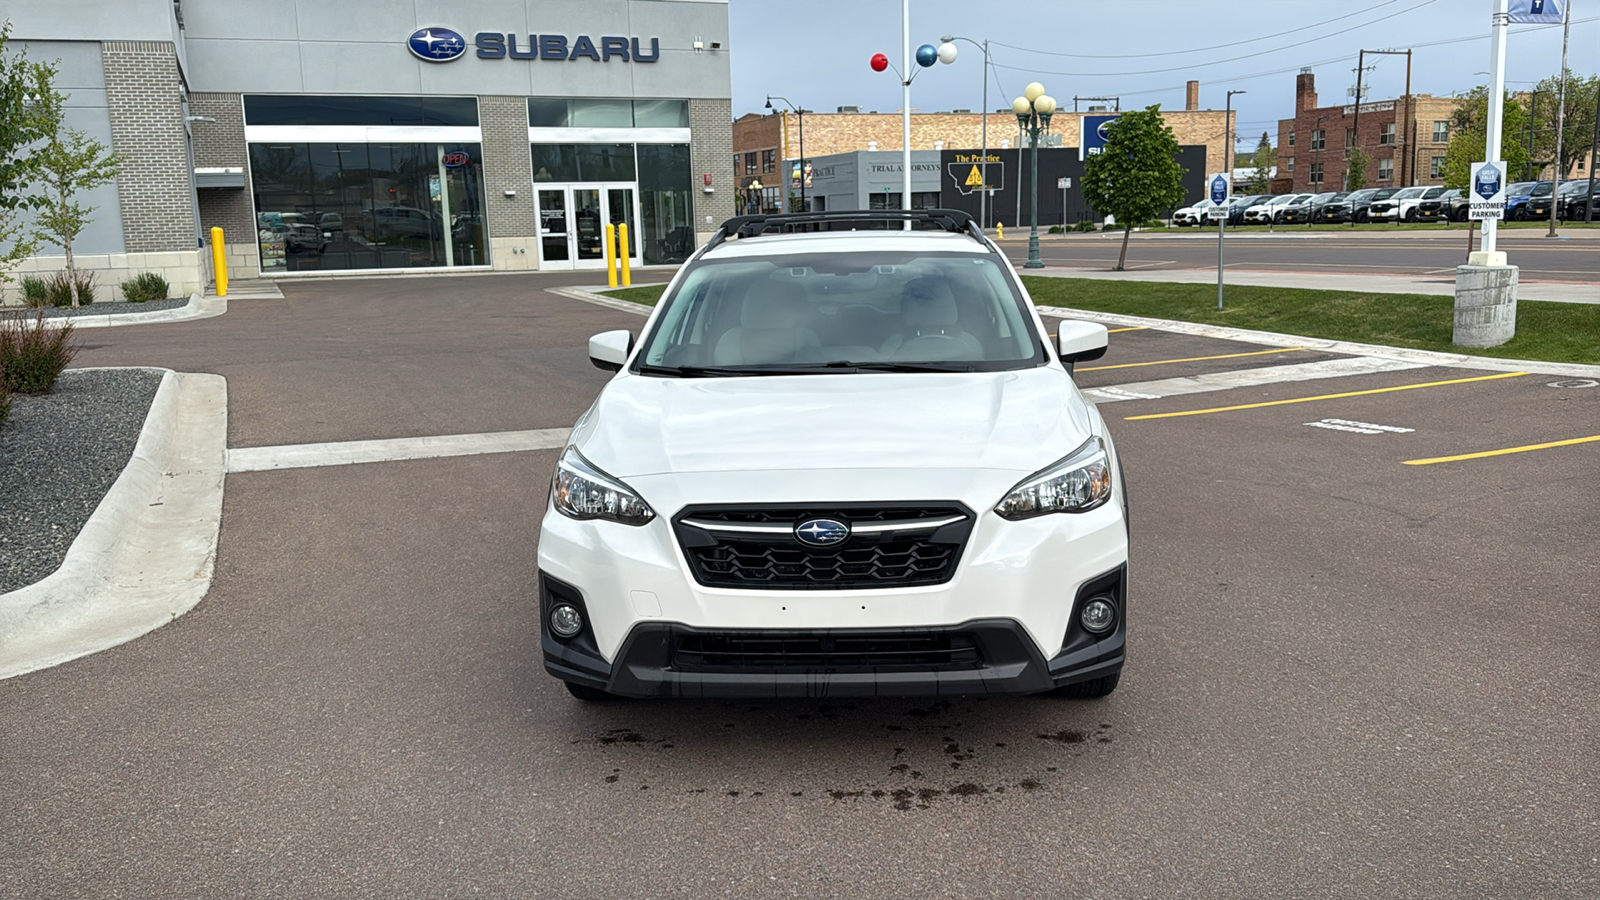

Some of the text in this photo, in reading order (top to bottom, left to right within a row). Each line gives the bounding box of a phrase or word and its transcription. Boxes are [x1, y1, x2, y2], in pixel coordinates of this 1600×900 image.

[475, 32, 660, 62] SUBARU
[442, 153, 467, 164] OPEN
[955, 154, 1000, 163] The Pratice
[871, 164, 941, 173] TRIAL AORNEYS
[1470, 202, 1505, 210] CUSTOMER
